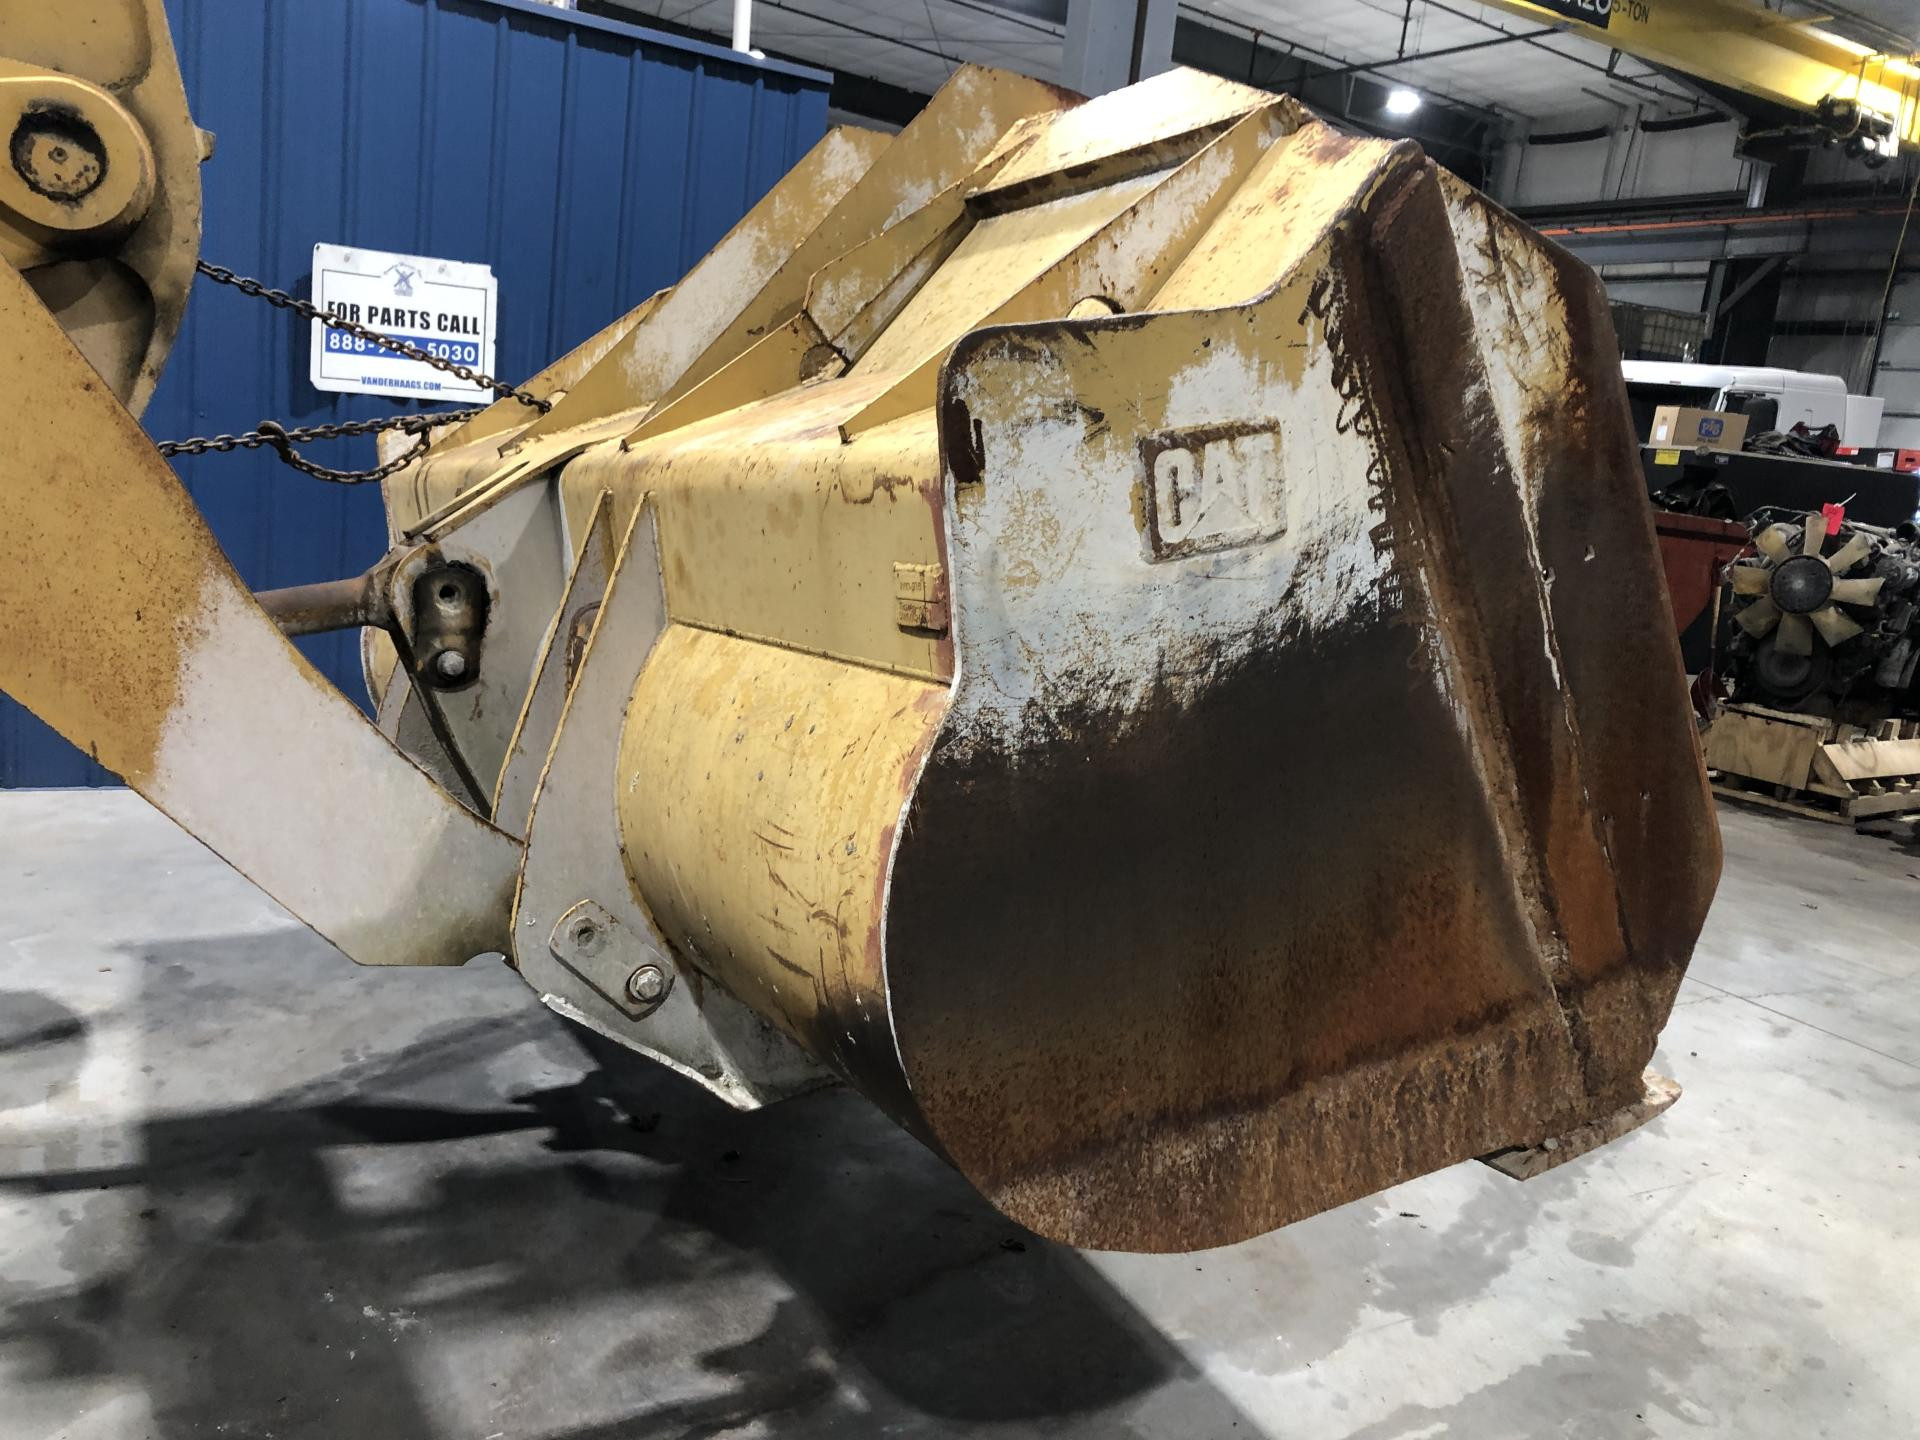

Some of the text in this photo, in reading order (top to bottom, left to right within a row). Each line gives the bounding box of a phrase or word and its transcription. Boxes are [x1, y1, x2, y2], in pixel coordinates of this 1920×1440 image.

[328, 301, 481, 336] FOR PARTS CALL
[361, 376, 442, 391] VANDERHAAGS.COM
[1153, 432, 1277, 544] CAT
